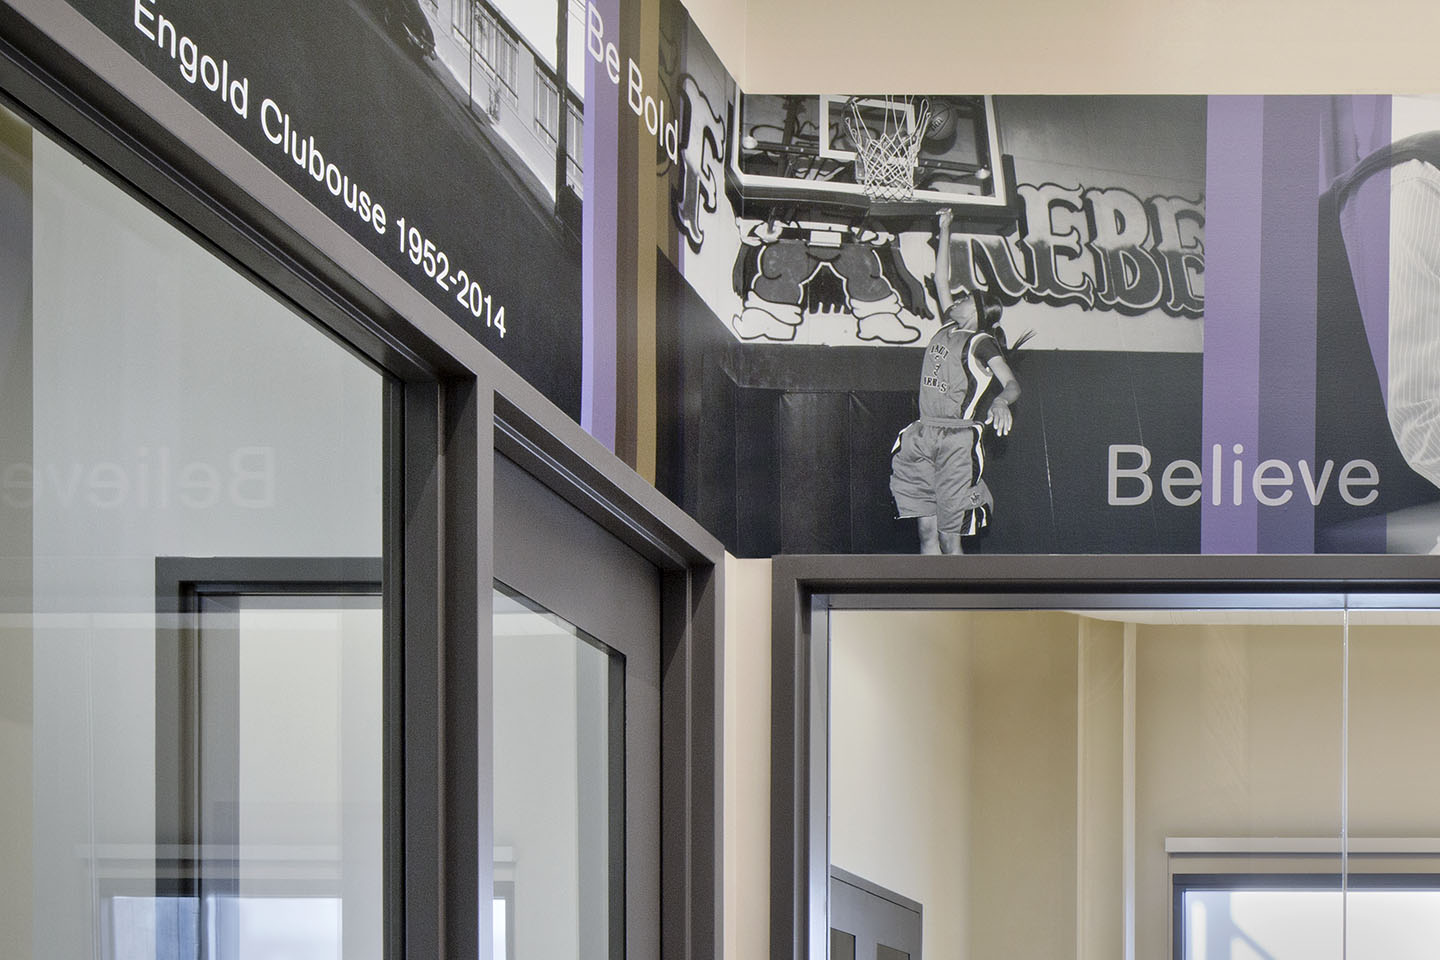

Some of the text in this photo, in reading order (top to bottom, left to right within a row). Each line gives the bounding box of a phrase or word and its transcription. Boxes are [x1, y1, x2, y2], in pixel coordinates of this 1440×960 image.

[587, 1, 678, 165] Be Bold
[134, 0, 506, 338] Engold Clubouse 1952-2014
[1106, 443, 1381, 507] Believe
